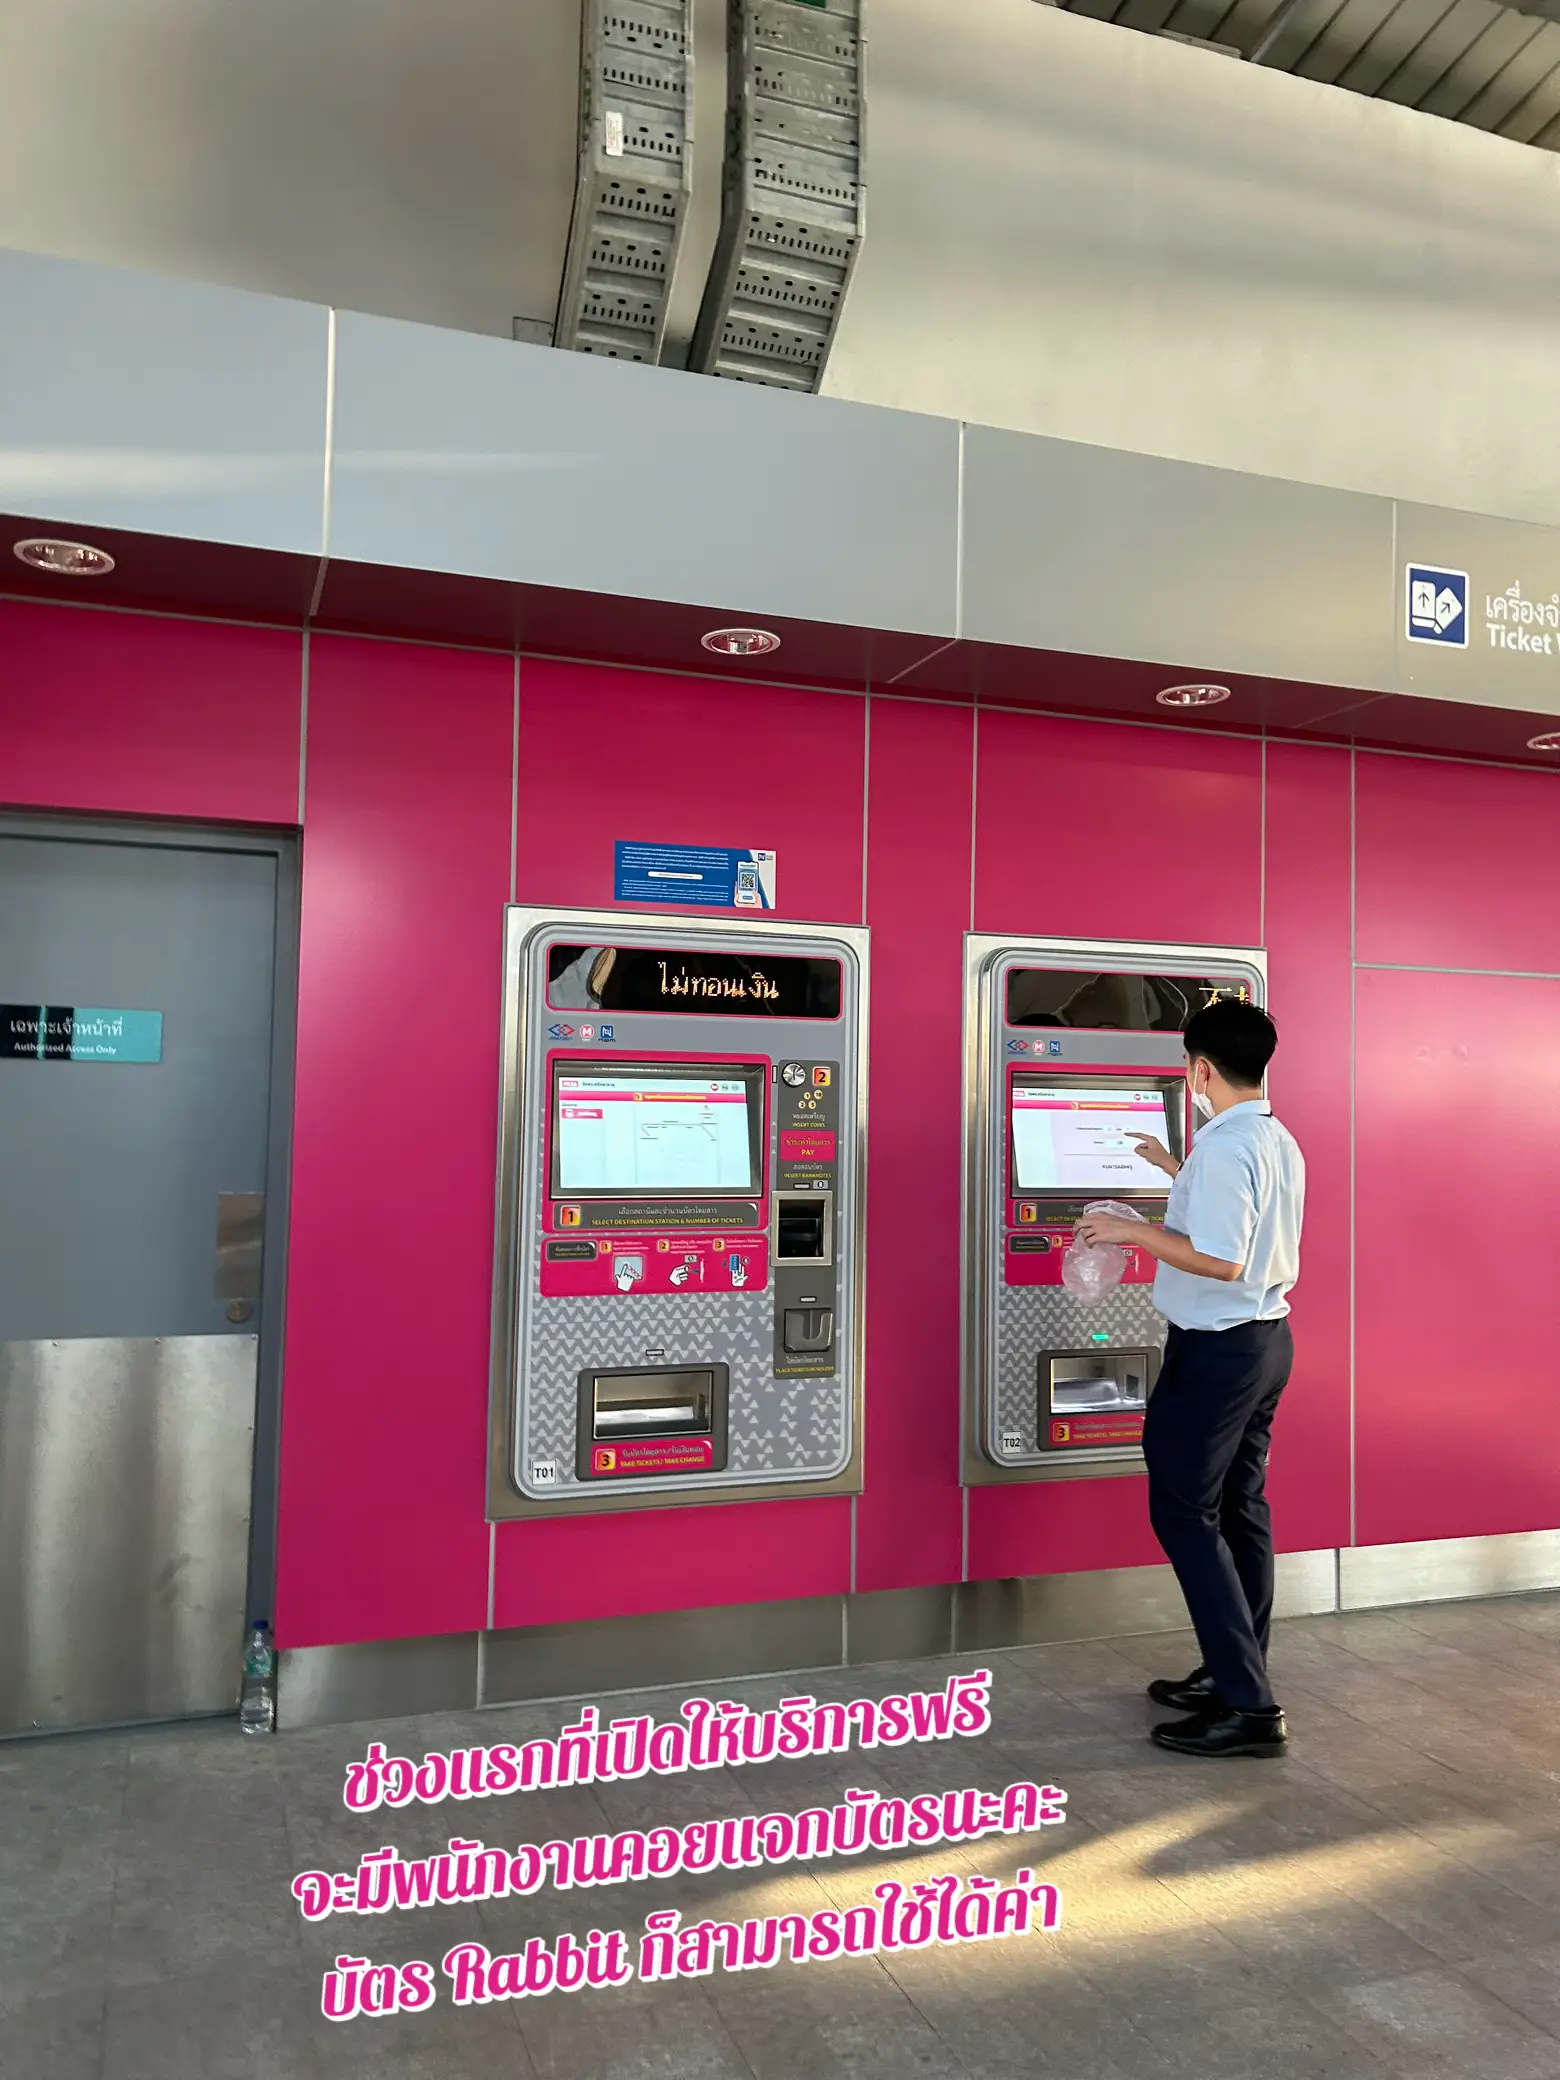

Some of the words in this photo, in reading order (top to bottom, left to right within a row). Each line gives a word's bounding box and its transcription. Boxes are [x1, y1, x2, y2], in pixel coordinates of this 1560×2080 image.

[1486, 622, 1553, 655] Ticket
[658, 961, 779, 999] ไม่ทอนเงิน
[10, 1015, 123, 1036] เฉพาะเจ้าหน้าที่
[65, 1043, 94, 1054] Access
[95, 1044, 117, 1056] Only
[818, 1071, 826, 1083] 2
[801, 1148, 815, 1156] PAY
[567, 1210, 574, 1223] 1
[1058, 1427, 1065, 1439] 3
[1003, 1437, 1020, 1448] T02
[601, 1453, 610, 1467] 3
[534, 1467, 553, 1478] T01
